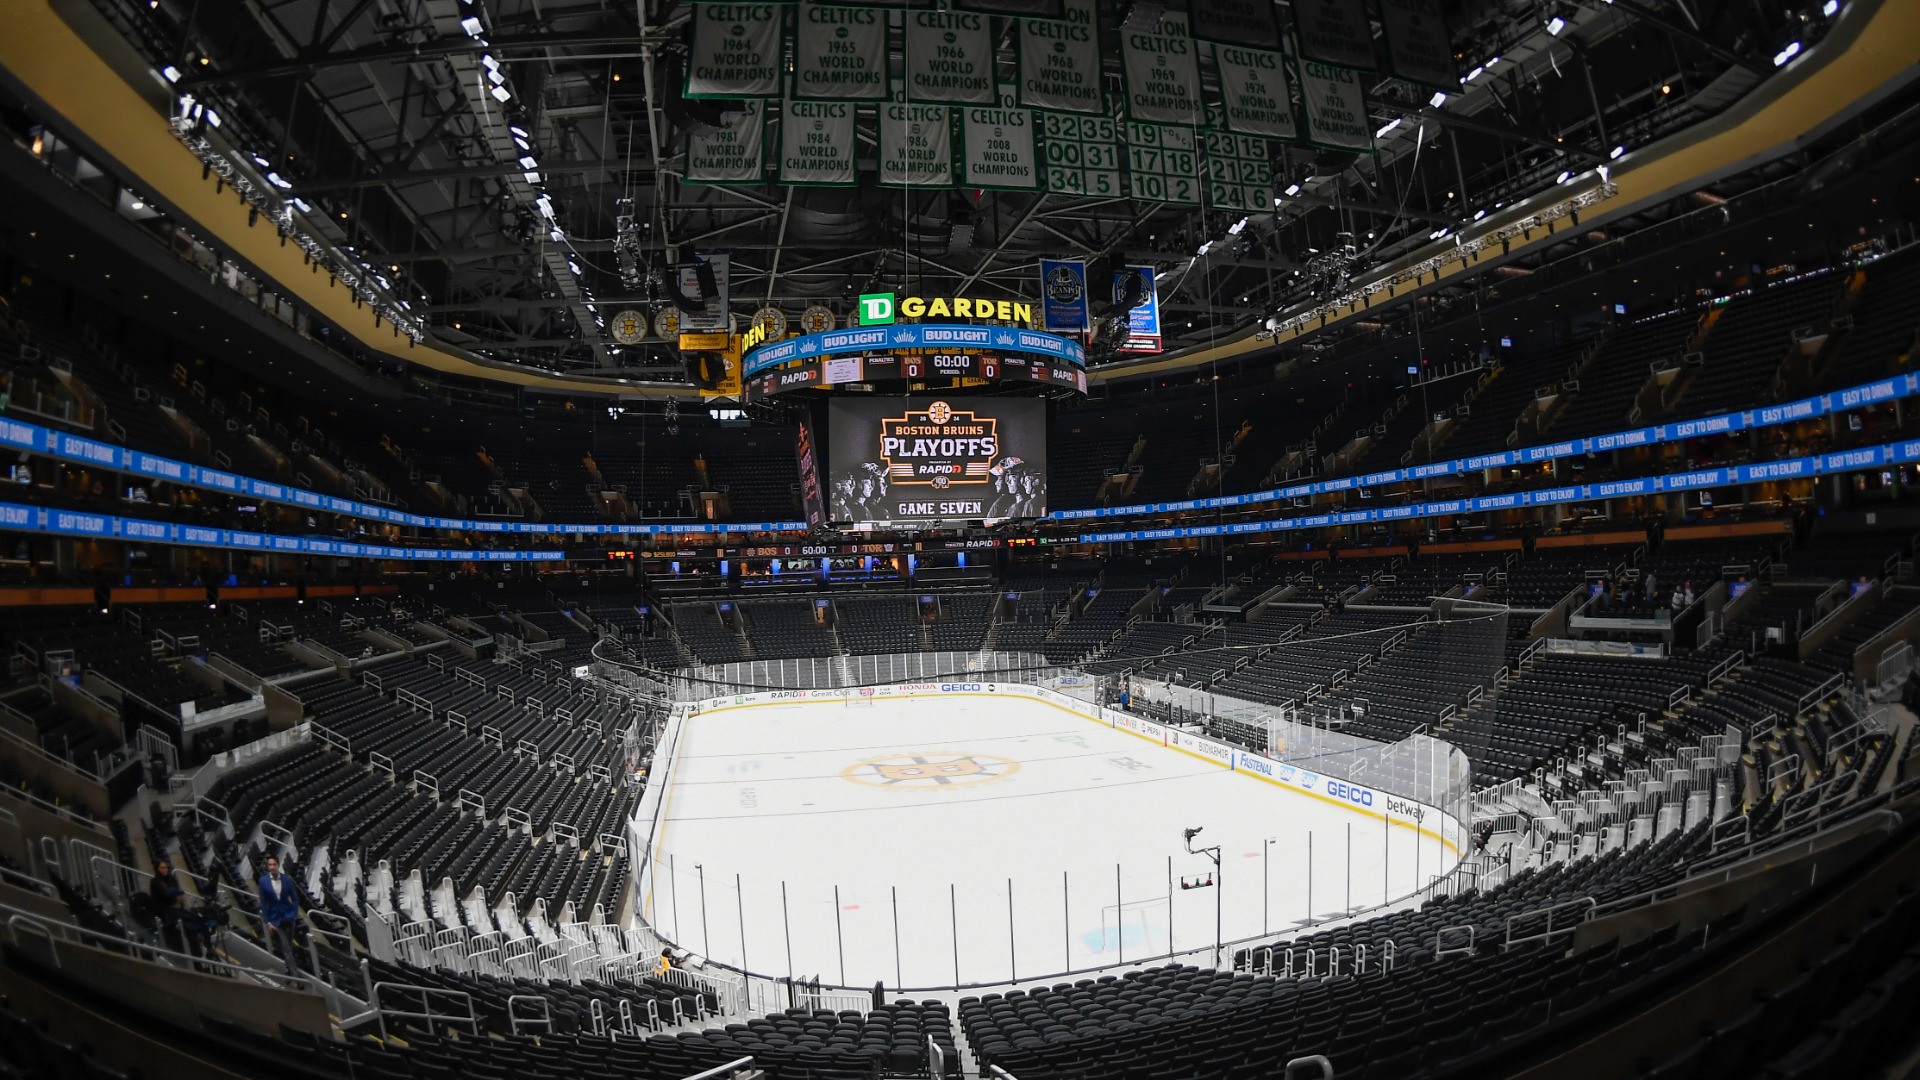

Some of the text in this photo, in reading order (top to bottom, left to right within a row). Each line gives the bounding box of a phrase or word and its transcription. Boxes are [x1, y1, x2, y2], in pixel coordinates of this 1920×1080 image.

[707, 4, 773, 21] CELTICS
[809, 7, 875, 25] CELTICS
[917, 11, 981, 31] CELTICS
[1028, 20, 1089, 41] CELTICS
[723, 39, 750, 50] 1964
[828, 41, 856, 54] 1965
[937, 46, 964, 58] 1966
[1130, 35, 1187, 54] CELTICS
[714, 53, 760, 65] WORLD
[820, 56, 865, 69] WORLD
[1047, 55, 1073, 68] 1968
[1224, 49, 1276, 69] CELTICS
[697, 66, 774, 81] CHAMPIONS
[929, 60, 973, 74] WORLD
[1152, 68, 1175, 80] 1969
[1306, 62, 1353, 84] CELTICS
[804, 70, 880, 84] CHAMPIONS
[915, 74, 989, 90] CHAMPIONS
[1040, 68, 1082, 84] WORLD
[1027, 80, 1097, 99] CHAMPIONS
[1145, 81, 1185, 96] WORLD
[1245, 82, 1266, 94] 1974
[1135, 94, 1199, 111] CHAMPIONS
[1239, 95, 1276, 109] WORLD
[791, 103, 846, 118] CELTICS
[888, 106, 942, 122] CELTICS
[971, 109, 1024, 126] CELTICS
[1231, 107, 1290, 124] CHAMPIONS
[1321, 108, 1354, 122] WORLD
[1047, 116, 1113, 139] 32 35
[1130, 125, 1156, 143] 19
[1313, 119, 1367, 137] CHAMPIONS
[716, 132, 737, 142] 1981
[807, 134, 830, 144] 1984
[987, 139, 1010, 150] 2008
[706, 145, 745, 156] WORLD
[800, 146, 837, 157] WORLD
[1207, 133, 1265, 157] 23 15
[898, 149, 936, 160] WORLD
[983, 151, 1017, 163] WORLD
[1048, 142, 1115, 166] 00 31
[1133, 150, 1192, 173] 17 18
[693, 158, 757, 169] CHAMPIONS
[786, 158, 849, 171] CHAMPIONS
[886, 161, 947, 174] CHAMPIONS
[972, 163, 1029, 176] CHAMPIONS
[1213, 160, 1270, 183] 21 25
[1051, 169, 1110, 193] 34 5
[1135, 175, 1191, 200] 10 2
[1214, 186, 1266, 208] 24 6
[862, 298, 892, 320] TD
[901, 297, 1031, 323] GARDEN
[814, 319, 822, 327] 15
[824, 331, 884, 347] BUD LIGHT
[925, 330, 988, 343] BUD LIGHT
[1021, 335, 1062, 350] BUD LIGHT
[758, 345, 793, 362] BUD LIGHT
[934, 355, 970, 367] 60:00
[781, 371, 817, 385] RAPID7
[909, 365, 917, 376] 0
[986, 366, 994, 377] 0
[1842, 382, 1894, 406] EASY TO DRINK
[1762, 401, 1812, 422] EASY TO DRINK
[896, 426, 984, 436] BOSTON BRUINS
[1677, 417, 1730, 436] EASY TO DRINK
[883, 437, 995, 457] PLAYOFFS
[919, 465, 962, 474] RAPID7
[1750, 461, 1802, 478] EASY TO ENJOY
[1670, 472, 1718, 487] EASY TO ENJOY
[898, 502, 981, 515] GAME SEVEN
[785, 547, 791, 555] 0
[802, 546, 826, 555] 60:00
[852, 545, 857, 553] 0
[863, 544, 883, 552] TOR
[771, 690, 806, 699] RAPID7
[834, 689, 850, 697] Clips
[941, 683, 980, 692] GEICO
[1240, 753, 1273, 776] FASTENAL
[1327, 780, 1373, 807] GEICO
[1387, 796, 1425, 823] betway
